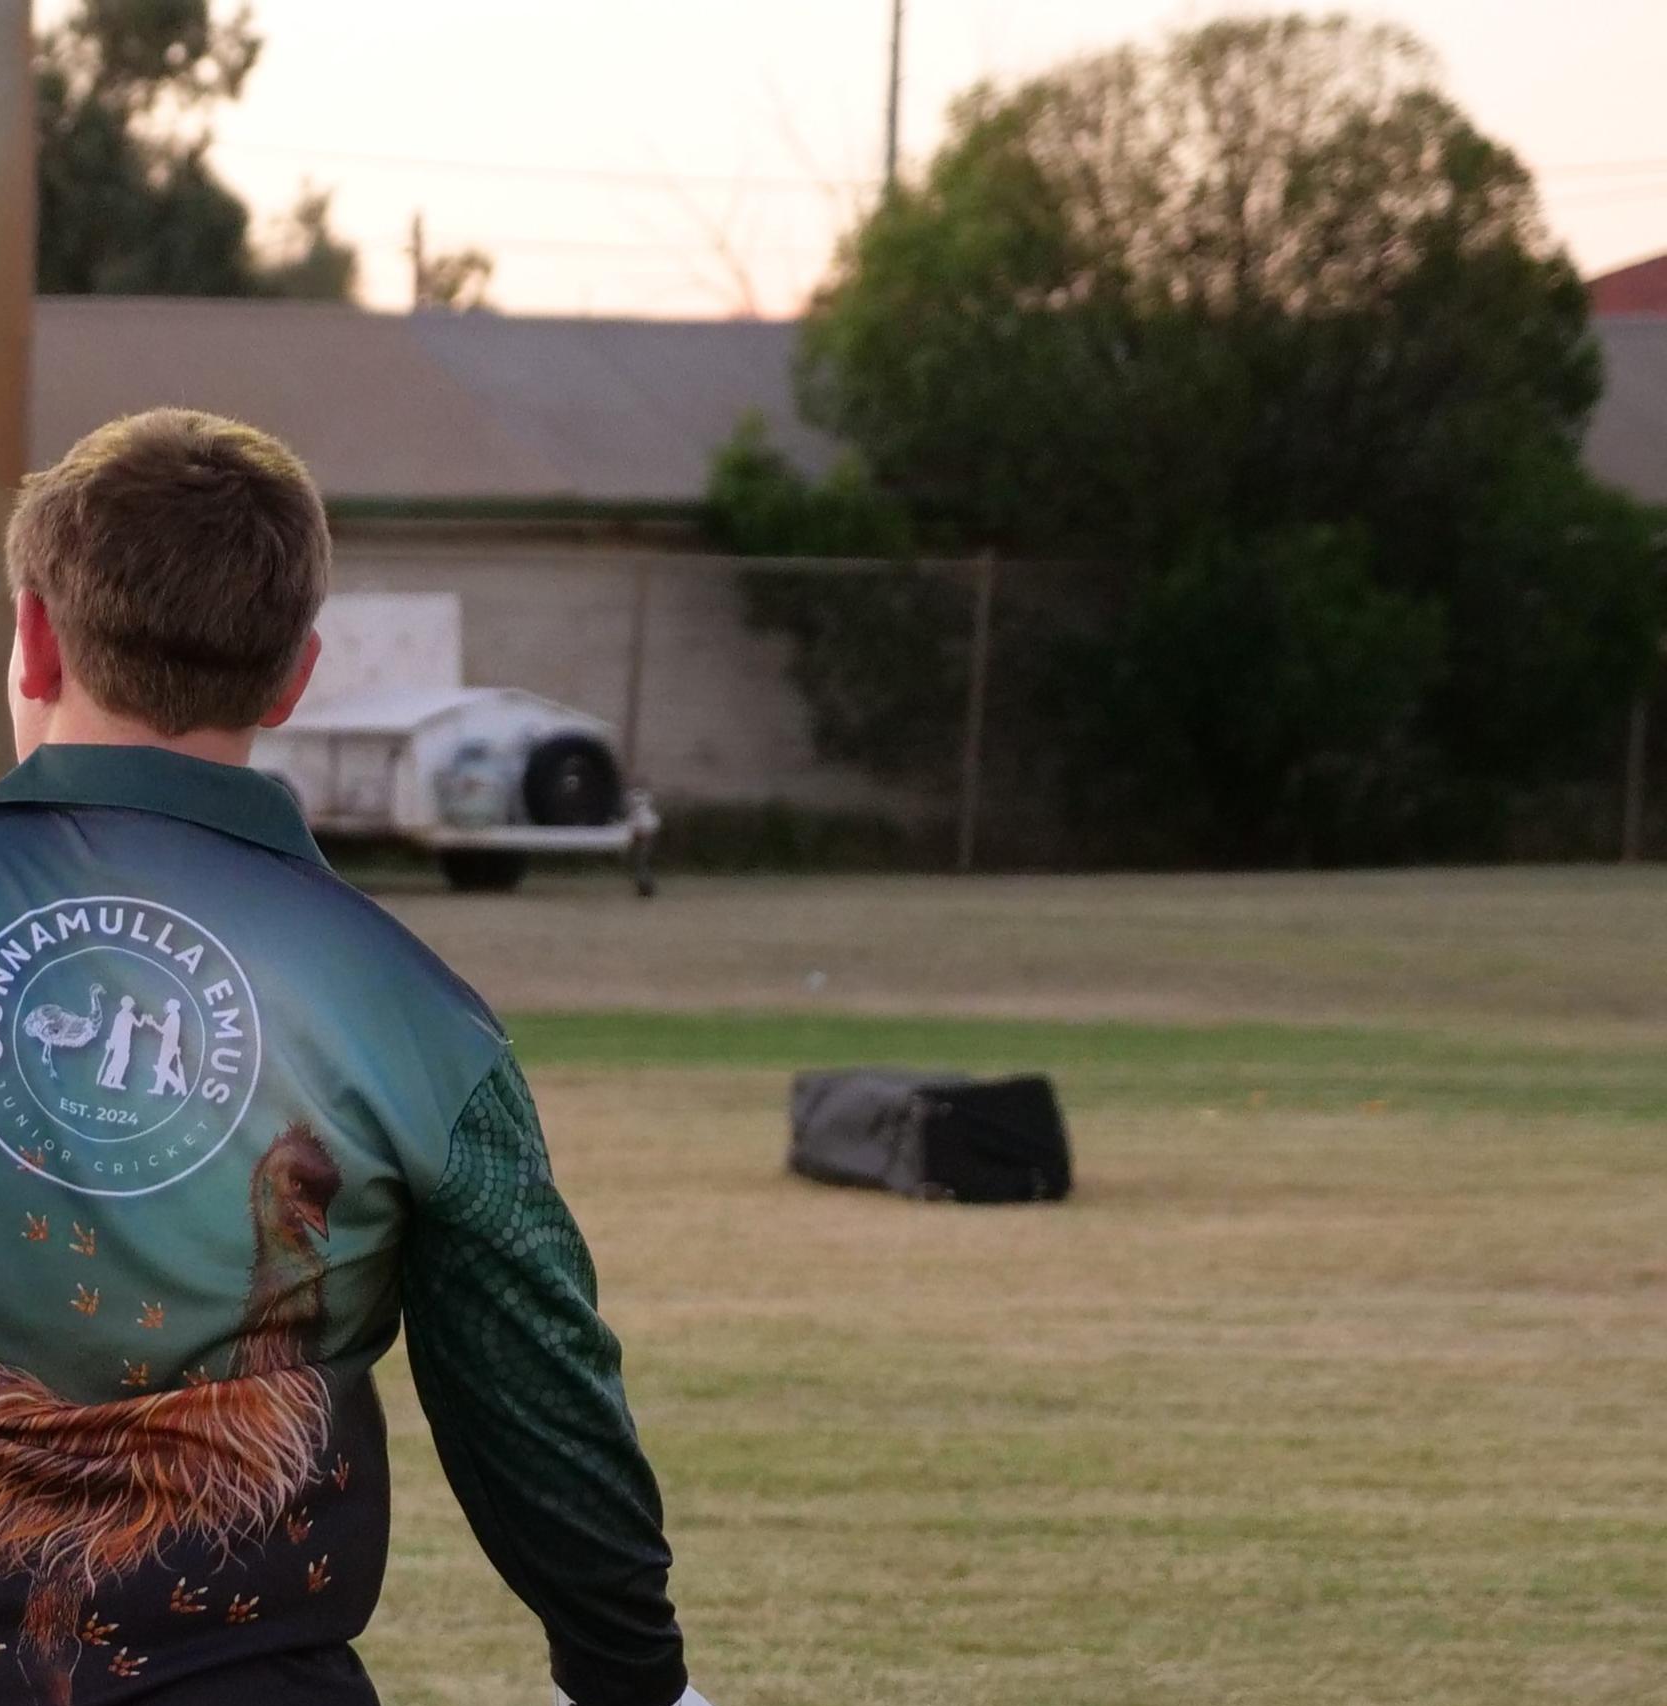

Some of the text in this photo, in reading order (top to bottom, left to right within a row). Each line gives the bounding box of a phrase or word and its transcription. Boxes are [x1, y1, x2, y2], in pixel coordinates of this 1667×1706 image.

[202, 978, 243, 1105] EMUS
[60, 1097, 139, 1125] EST. 2024
[94, 1120, 209, 1175] CRICKET
